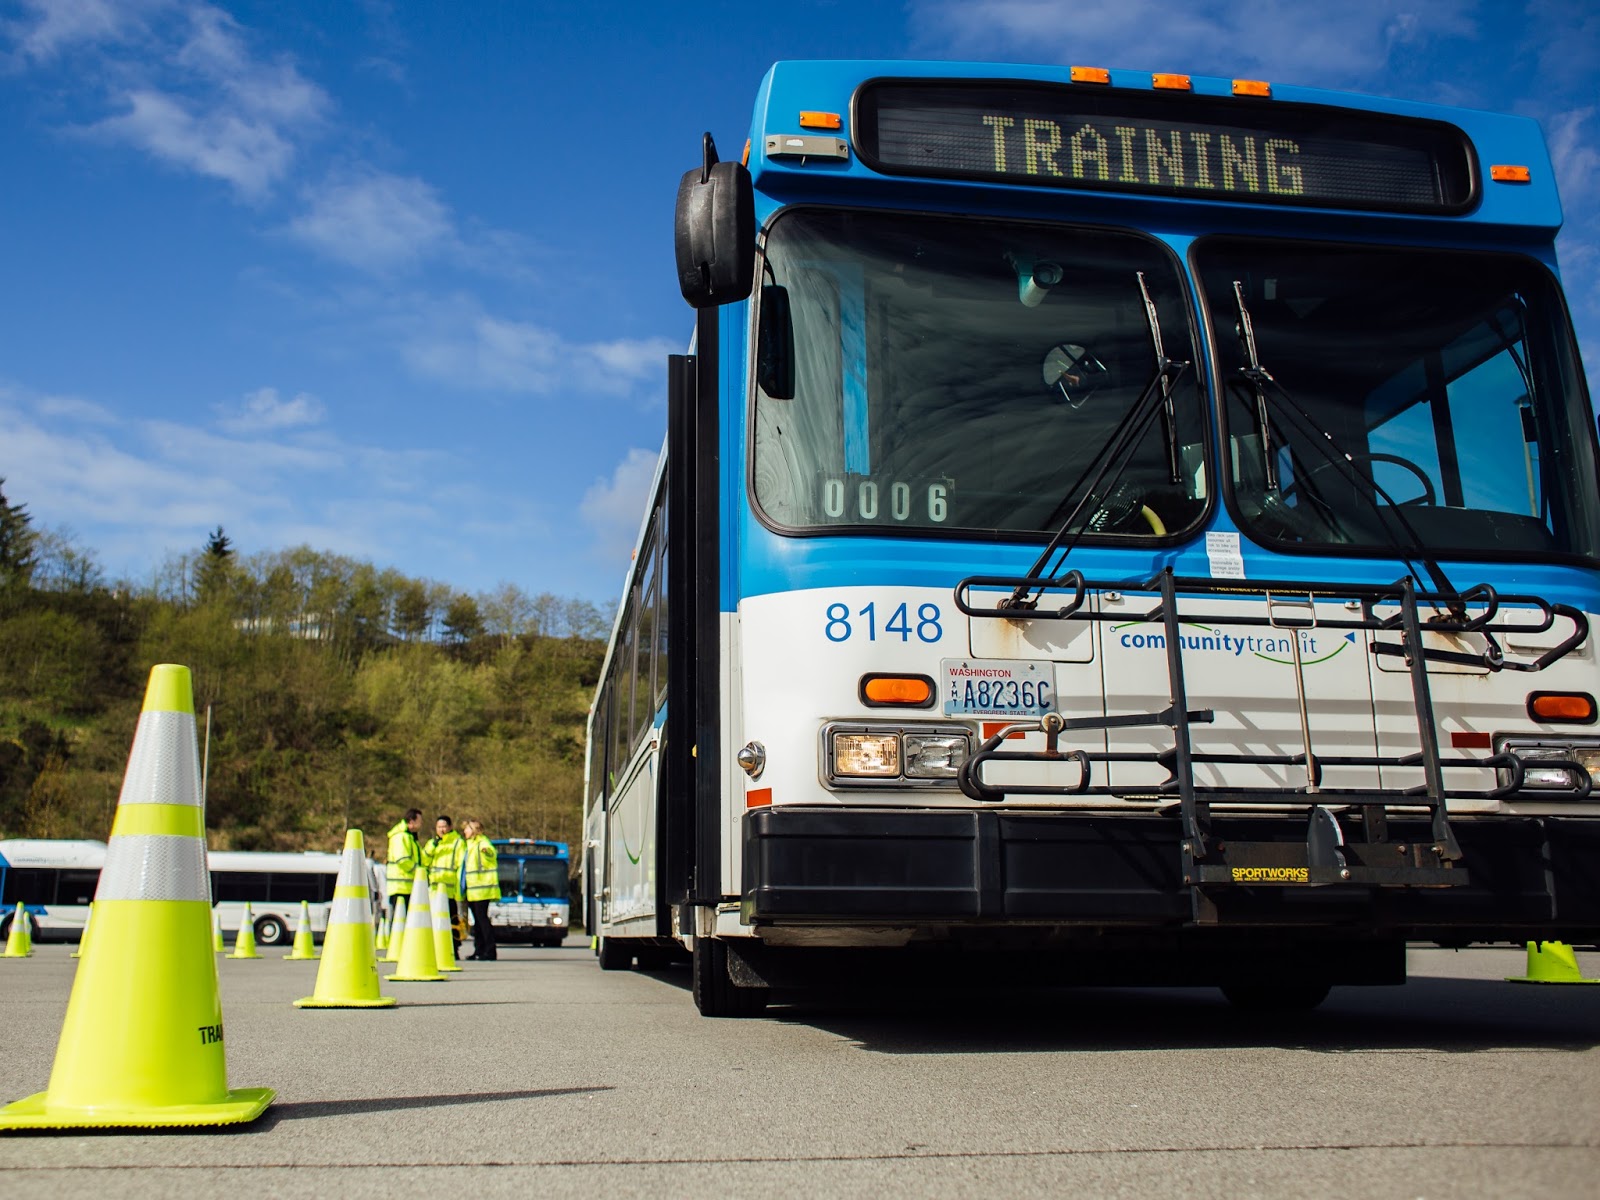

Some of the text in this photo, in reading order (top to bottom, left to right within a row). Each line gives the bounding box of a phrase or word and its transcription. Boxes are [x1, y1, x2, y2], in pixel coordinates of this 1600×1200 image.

[982, 115, 1304, 196] TRAINING
[824, 479, 948, 523] 0006
[825, 601, 943, 643] 8148
[1120, 629, 1318, 656] comunitytranit
[949, 667, 1012, 678] WASHINGTON
[963, 679, 1051, 709] A8236C
[1231, 867, 1308, 878] SPORTWORKS
